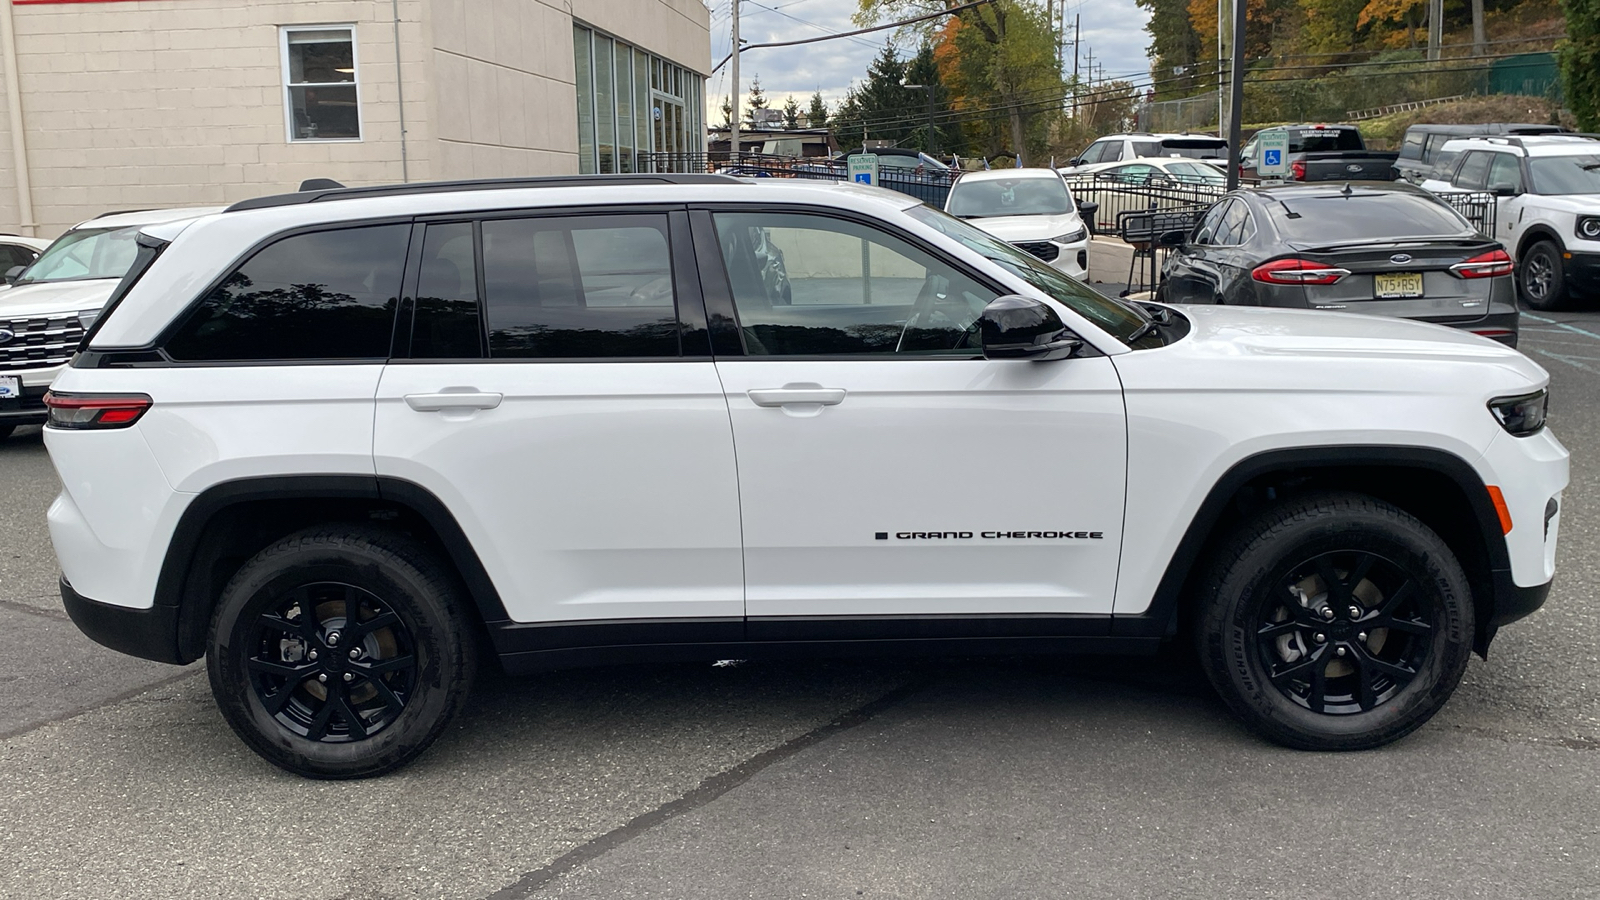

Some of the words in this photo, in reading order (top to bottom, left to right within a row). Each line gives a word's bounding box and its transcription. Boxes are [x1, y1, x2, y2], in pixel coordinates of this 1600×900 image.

[1376, 279, 1396, 292] N75
[1401, 278, 1420, 291] RSY
[895, 531, 974, 540] GRAND
[980, 531, 1104, 540] CHEROKEE
[1438, 577, 1460, 640] MICHELIN
[1232, 629, 1255, 692] MICHELIN
